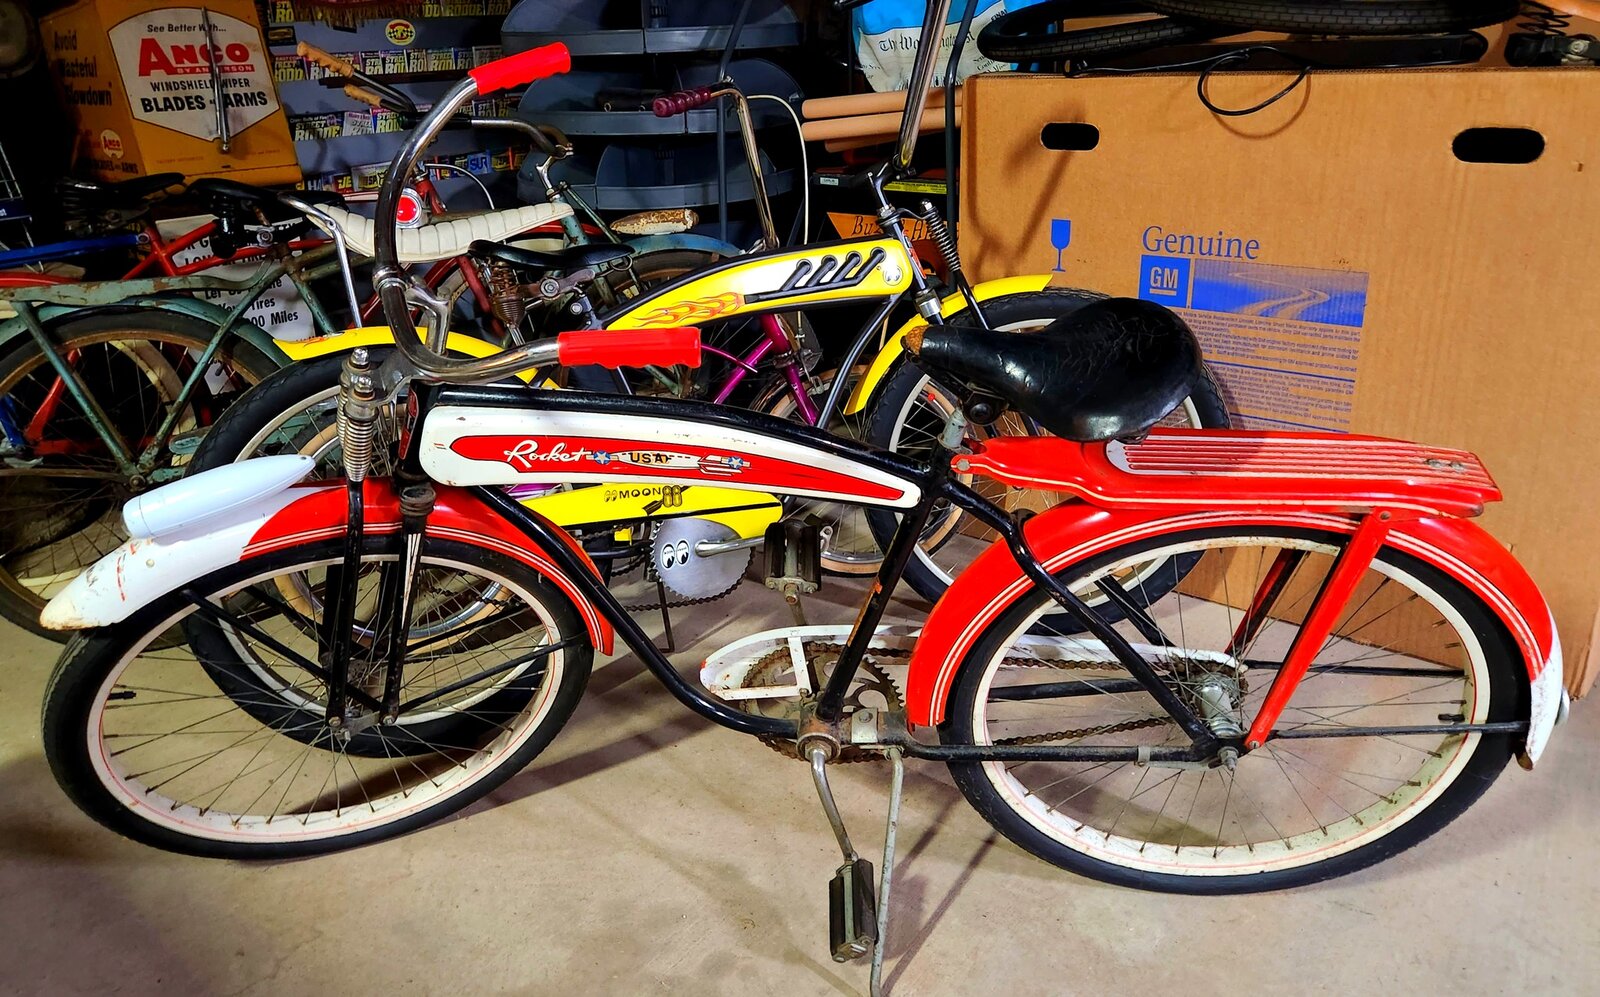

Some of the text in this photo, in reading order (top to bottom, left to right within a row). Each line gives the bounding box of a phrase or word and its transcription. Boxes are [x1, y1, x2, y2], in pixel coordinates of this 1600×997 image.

[147, 24, 165, 33] See
[167, 23, 196, 33] Better
[54, 29, 77, 50] Avoid
[221, 78, 250, 89] WIPER
[140, 94, 206, 113] BLADES
[223, 91, 268, 109] ARMS
[1142, 225, 1260, 260] Genuine
[1150, 266, 1179, 289] GM
[270, 311, 299, 326] Miles
[503, 439, 592, 468] Rocket
[619, 487, 661, 499] MOON
